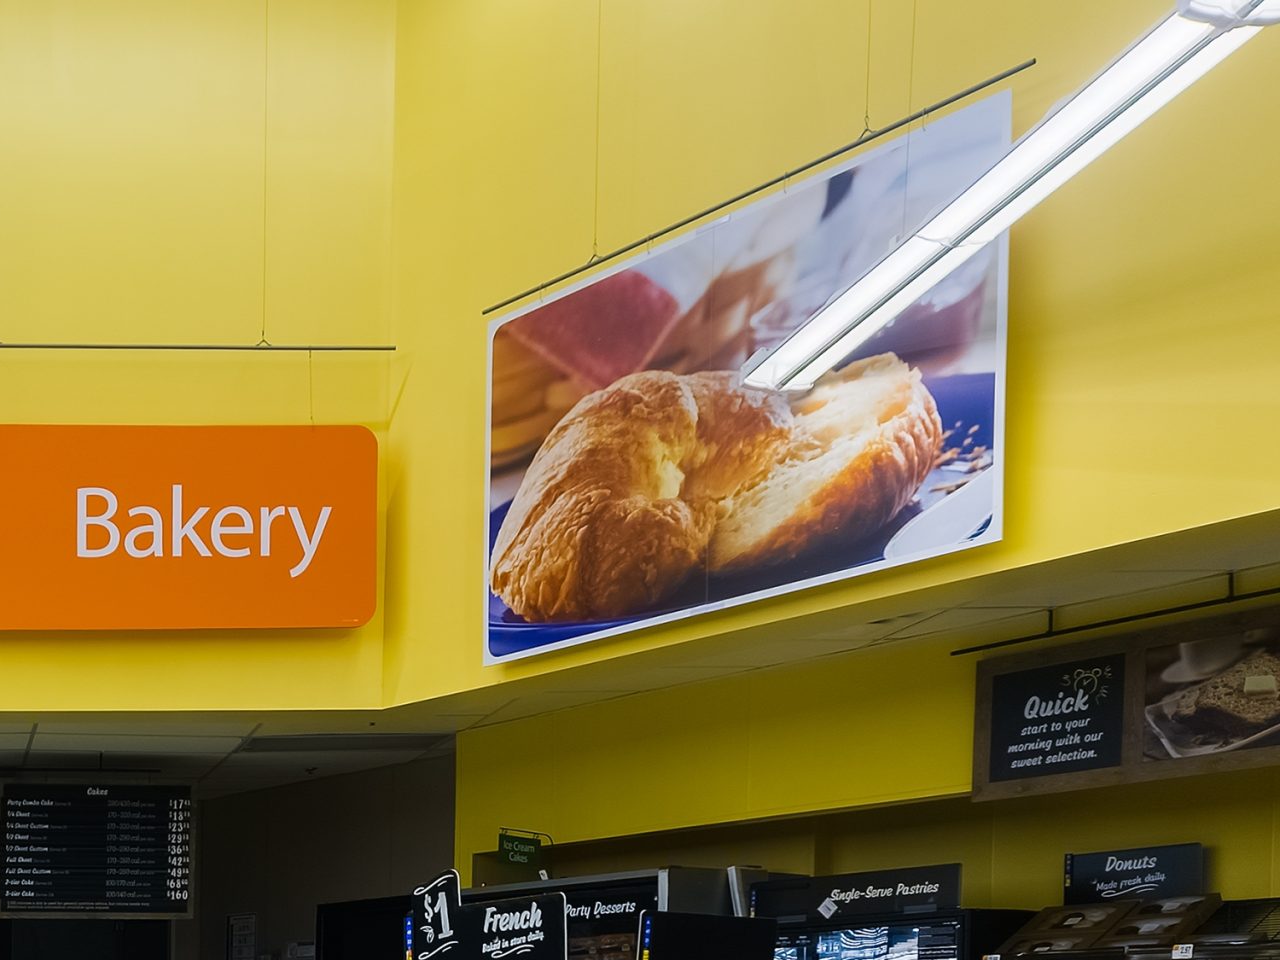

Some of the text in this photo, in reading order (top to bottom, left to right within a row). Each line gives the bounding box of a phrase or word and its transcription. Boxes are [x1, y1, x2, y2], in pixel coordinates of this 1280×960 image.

[75, 484, 333, 578] Bakery
[1023, 688, 1090, 720] Quick
[1020, 718, 1091, 736] start to your
[1007, 732, 1104, 754] morning with our
[1010, 748, 1098, 769] sweet selection.
[87, 787, 109, 796] Cakes
[503, 840, 535, 853] Ice Cream
[509, 852, 528, 863] Cakes
[1105, 855, 1157, 872] Donuts
[1096, 880, 1118, 891] Made
[1119, 875, 1142, 890] fresh
[830, 881, 939, 904] Single-Serve Pastries
[423, 891, 454, 940] $1
[483, 900, 543, 934] French
[566, 901, 637, 919] Party Desserts
[501, 938, 510, 948] in
[510, 936, 526, 947] store
